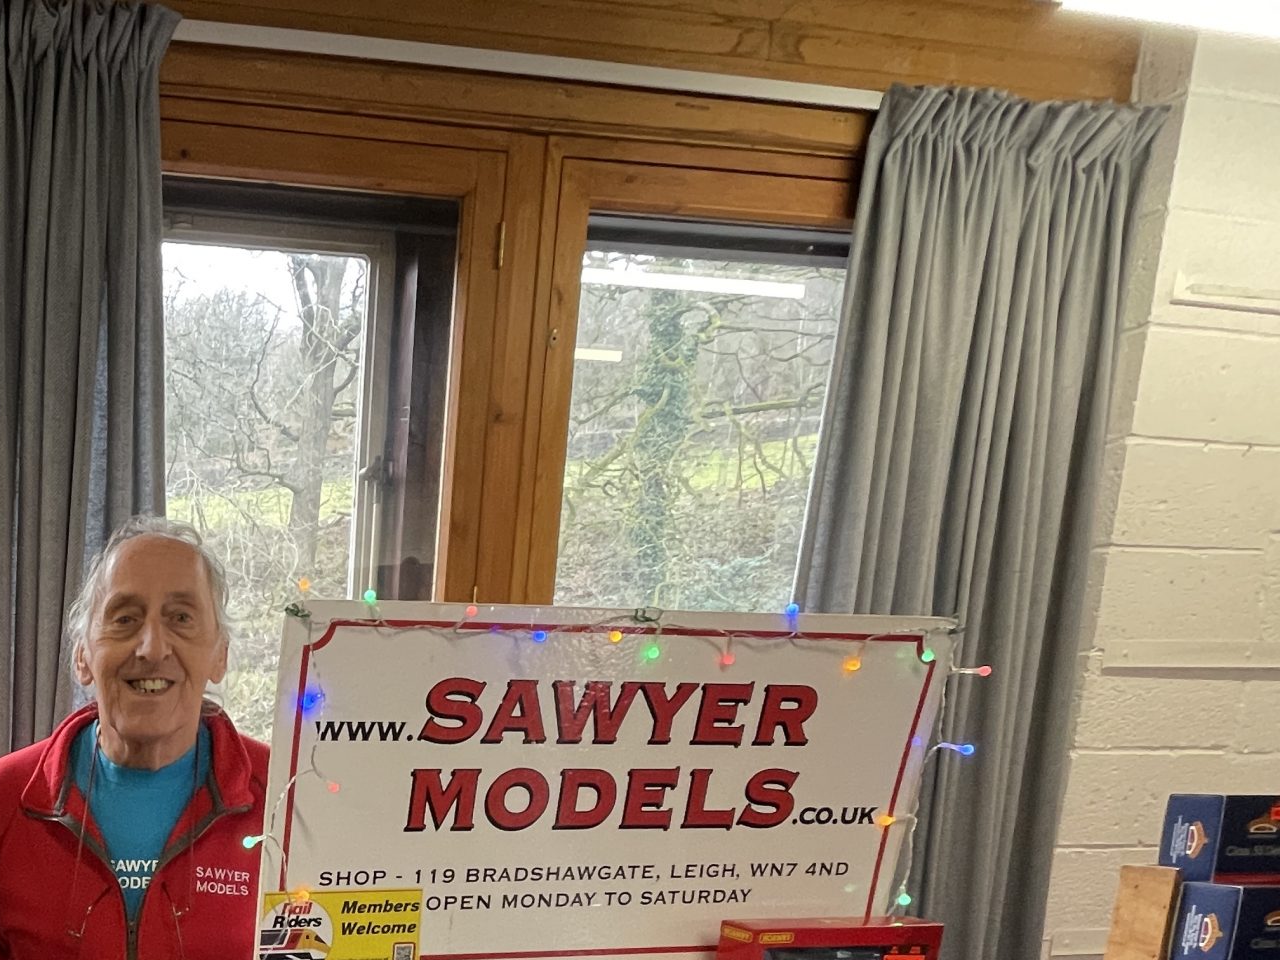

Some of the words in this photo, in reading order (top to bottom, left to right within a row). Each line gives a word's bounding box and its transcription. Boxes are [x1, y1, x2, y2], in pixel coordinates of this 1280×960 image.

[196, 866, 250, 883] SAWYER
[319, 870, 387, 887] SHOP
[415, 868, 456, 885] 119
[465, 864, 661, 884] BRADSHAWGATE,
[670, 863, 741, 880] LEIGH,
[749, 862, 799, 877] WN7
[805, 862, 850, 877] 4ND
[196, 881, 249, 896] MODELS
[340, 899, 420, 914] Members
[426, 894, 492, 911] OPEN
[501, 891, 598, 909] MONDAY
[604, 891, 633, 907] TO
[639, 888, 753, 906] SATURDAY
[340, 922, 417, 935] Welcome
